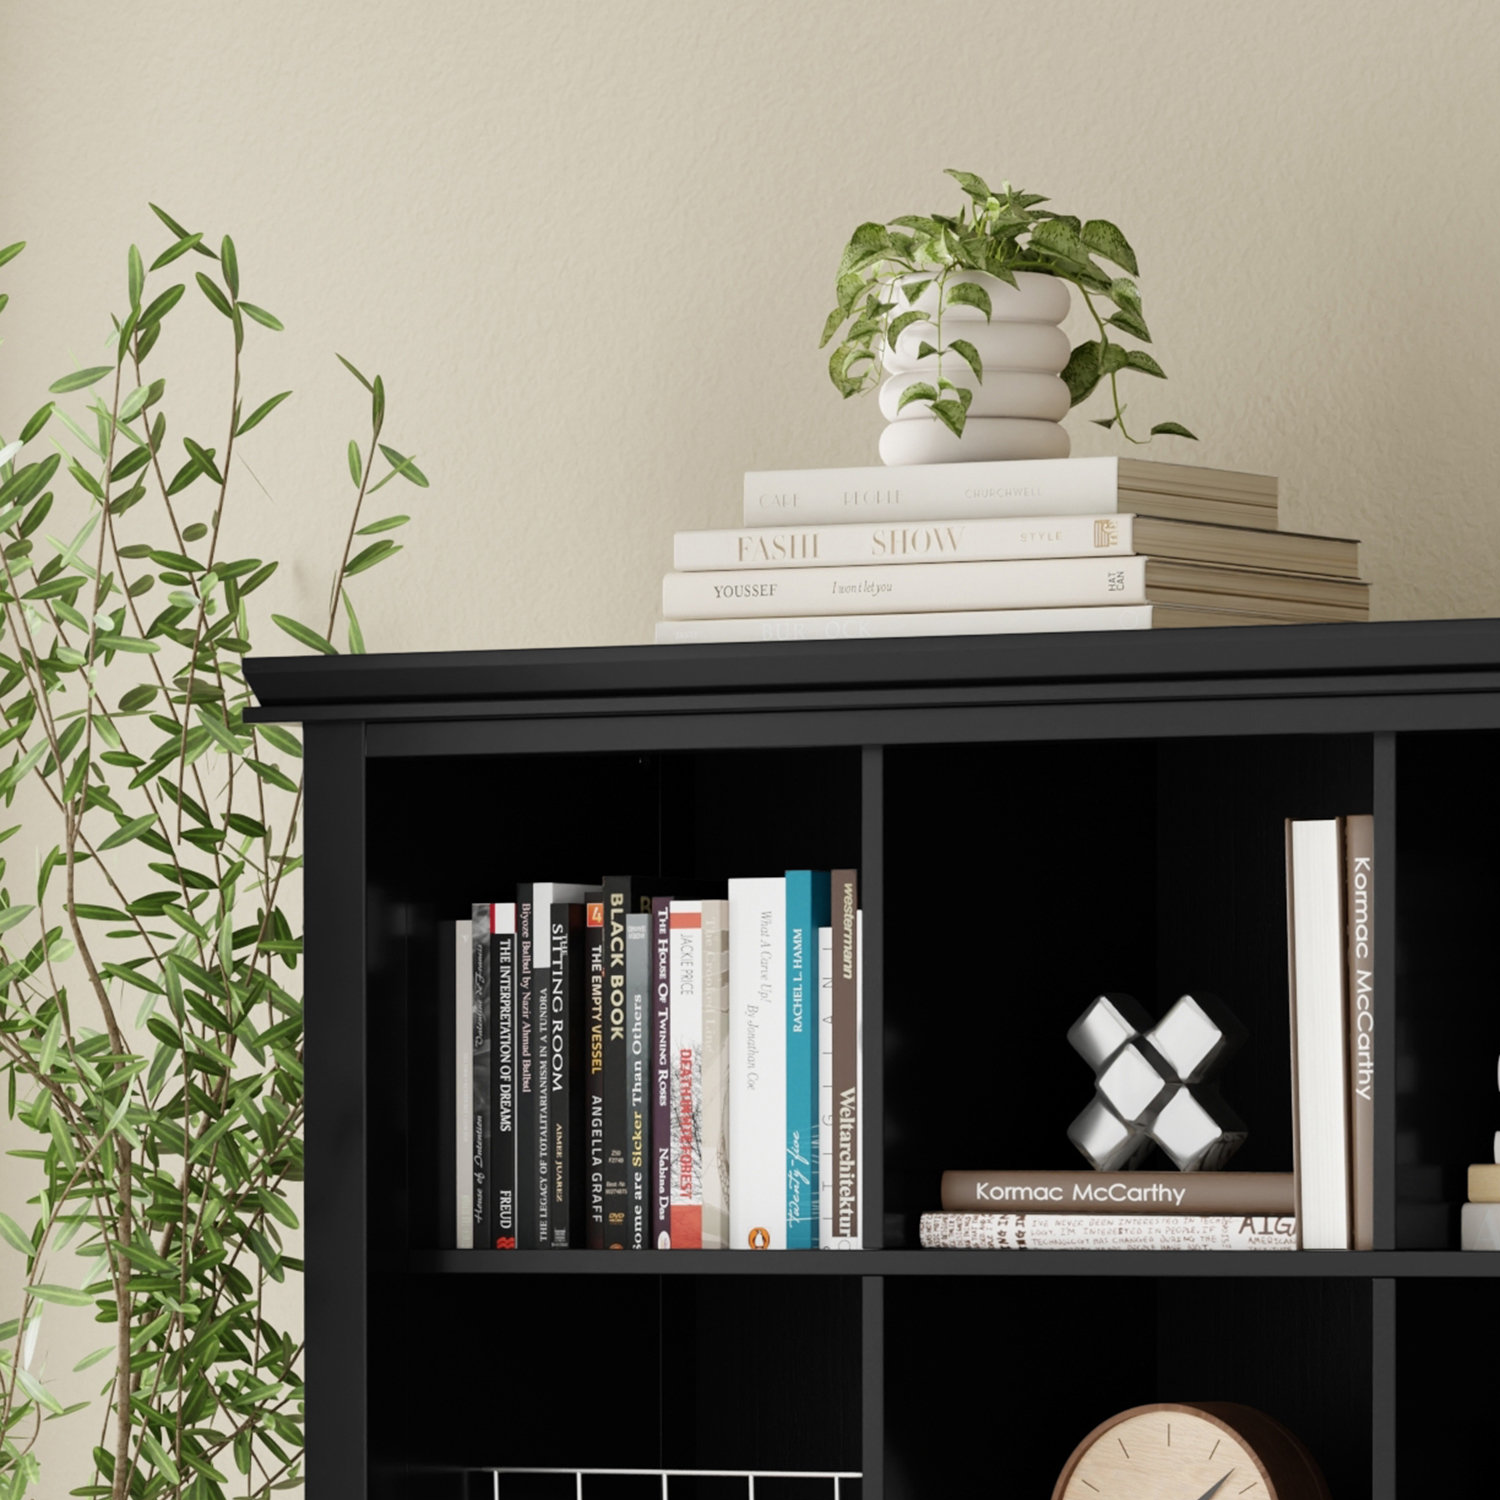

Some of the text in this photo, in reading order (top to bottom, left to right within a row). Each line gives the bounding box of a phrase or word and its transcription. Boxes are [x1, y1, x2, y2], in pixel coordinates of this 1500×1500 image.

[872, 527, 966, 557] SHOW
[1020, 531, 1063, 542] STYLE
[713, 583, 778, 599] YOUSSEF
[1107, 571, 1116, 592] HAT
[1116, 571, 1125, 592] CAN
[658, 906, 669, 935] THE
[760, 911, 772, 937] What
[843, 883, 855, 980] westermann
[520, 903, 531, 1055] Biyoze by Nazir Ahmad
[610, 892, 624, 1042] BLACK BOOK
[658, 938, 669, 979] HOUSE
[680, 934, 694, 996] JACKIE PRICE
[760, 951, 772, 980] Carve
[792, 928, 803, 1032] RACHEL HAMM
[1354, 857, 1374, 1101] Kormac McCarthy
[539, 988, 548, 1032] TUNDRA
[552, 923, 564, 1092] SITTING ROOM
[591, 944, 602, 1075] THE EMPTY VESSEL
[631, 994, 642, 1055] Others
[745, 1004, 759, 1017] By
[500, 938, 512, 1132] THE INTERPRETATION OF DREAMS
[540, 1045, 548, 1058] IN
[658, 1007, 669, 1066] TWINING
[746, 1020, 759, 1068] Jonathan
[632, 1060, 643, 1107] Than
[657, 1069, 669, 1107] ROSES
[591, 1095, 602, 1223] ANGELLA GRAFF
[631, 1111, 643, 1167] Sicker
[539, 1162, 548, 1175] OF
[555, 1160, 563, 1202] JUAREZ
[659, 1147, 669, 1221] Nabina Das
[680, 1145, 692, 1198] FOREST
[839, 1087, 856, 1238] Weltarchitektur
[539, 1176, 548, 1219] LEGACY
[633, 1171, 643, 1200] are
[975, 1181, 1187, 1206] Kormac McCarthy
[499, 1190, 512, 1229] FREUD
[539, 1220, 548, 1243] THE
